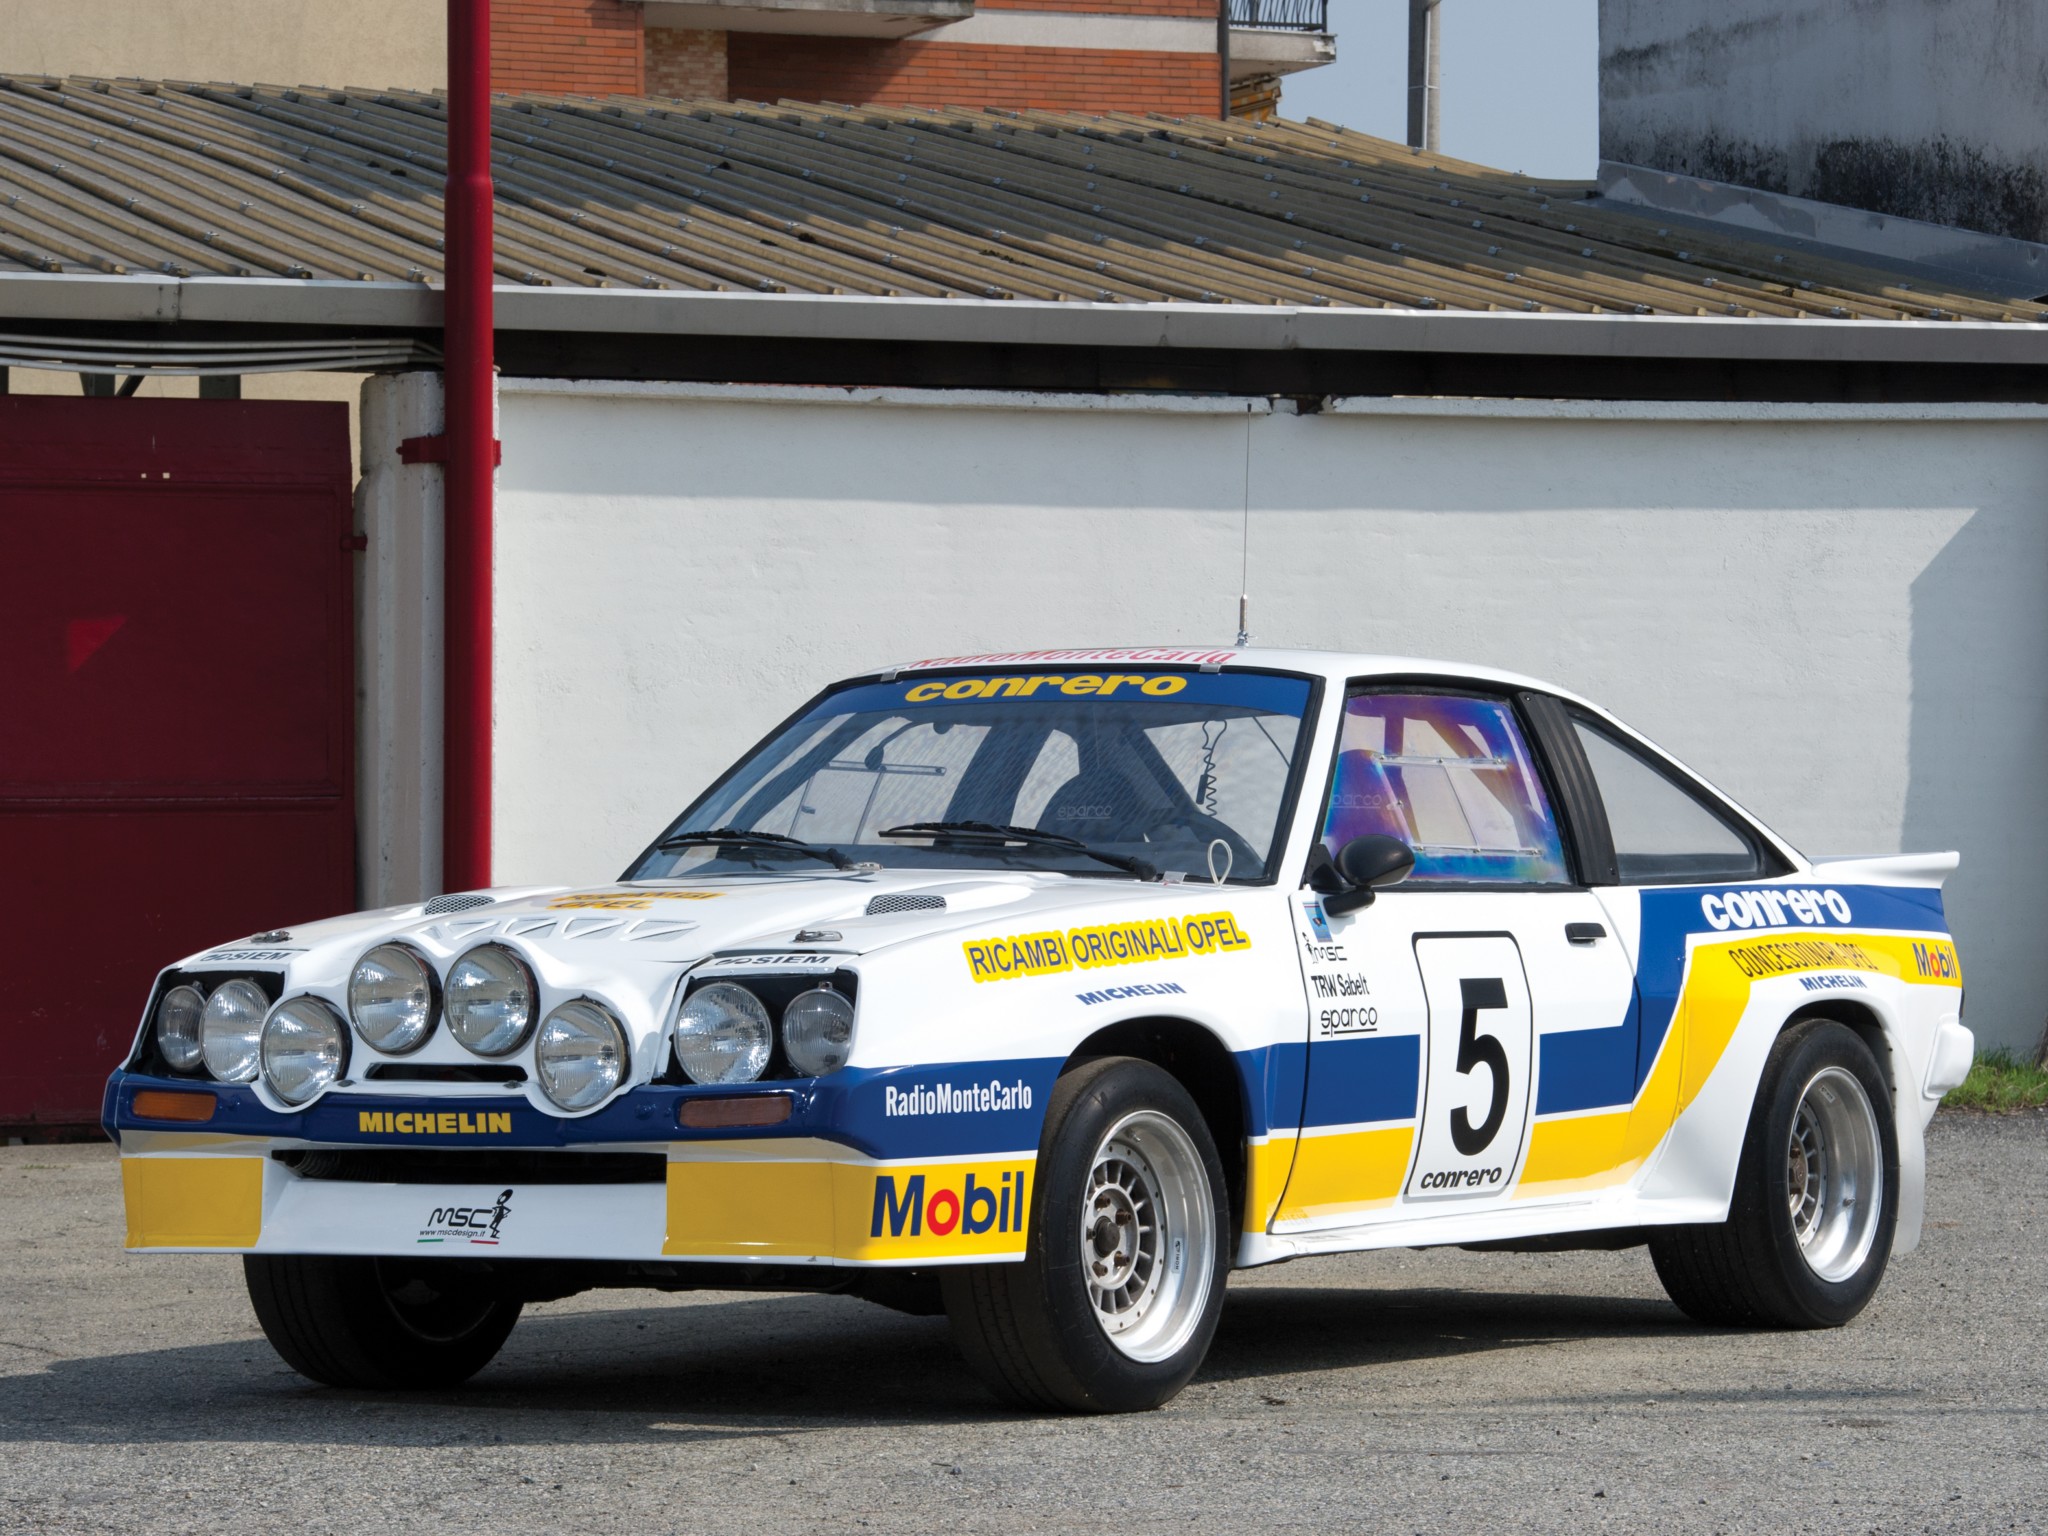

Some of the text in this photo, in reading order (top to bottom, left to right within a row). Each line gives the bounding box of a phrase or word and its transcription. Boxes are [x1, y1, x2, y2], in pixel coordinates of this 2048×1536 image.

[905, 675, 1187, 702] conrero
[1701, 889, 1852, 931] conrero
[968, 918, 1246, 975] RICAMBI ORIGINALI OPEL
[1314, 945, 1348, 961] MSC
[1912, 943, 1957, 979] Mobil
[1075, 983, 1187, 1005] MICHELIN
[1311, 972, 1370, 998] TRW Sabelt
[1799, 975, 1868, 991] MICHELIN
[1321, 1007, 1378, 1037] sparco
[1450, 977, 1510, 1156] 5
[886, 1079, 1032, 1117] RadioMonteCarlo
[359, 1112, 512, 1134] MICHELIN
[1420, 1166, 1502, 1190] conrero
[427, 1207, 493, 1229] MSC
[870, 1171, 1024, 1238] Mobil
